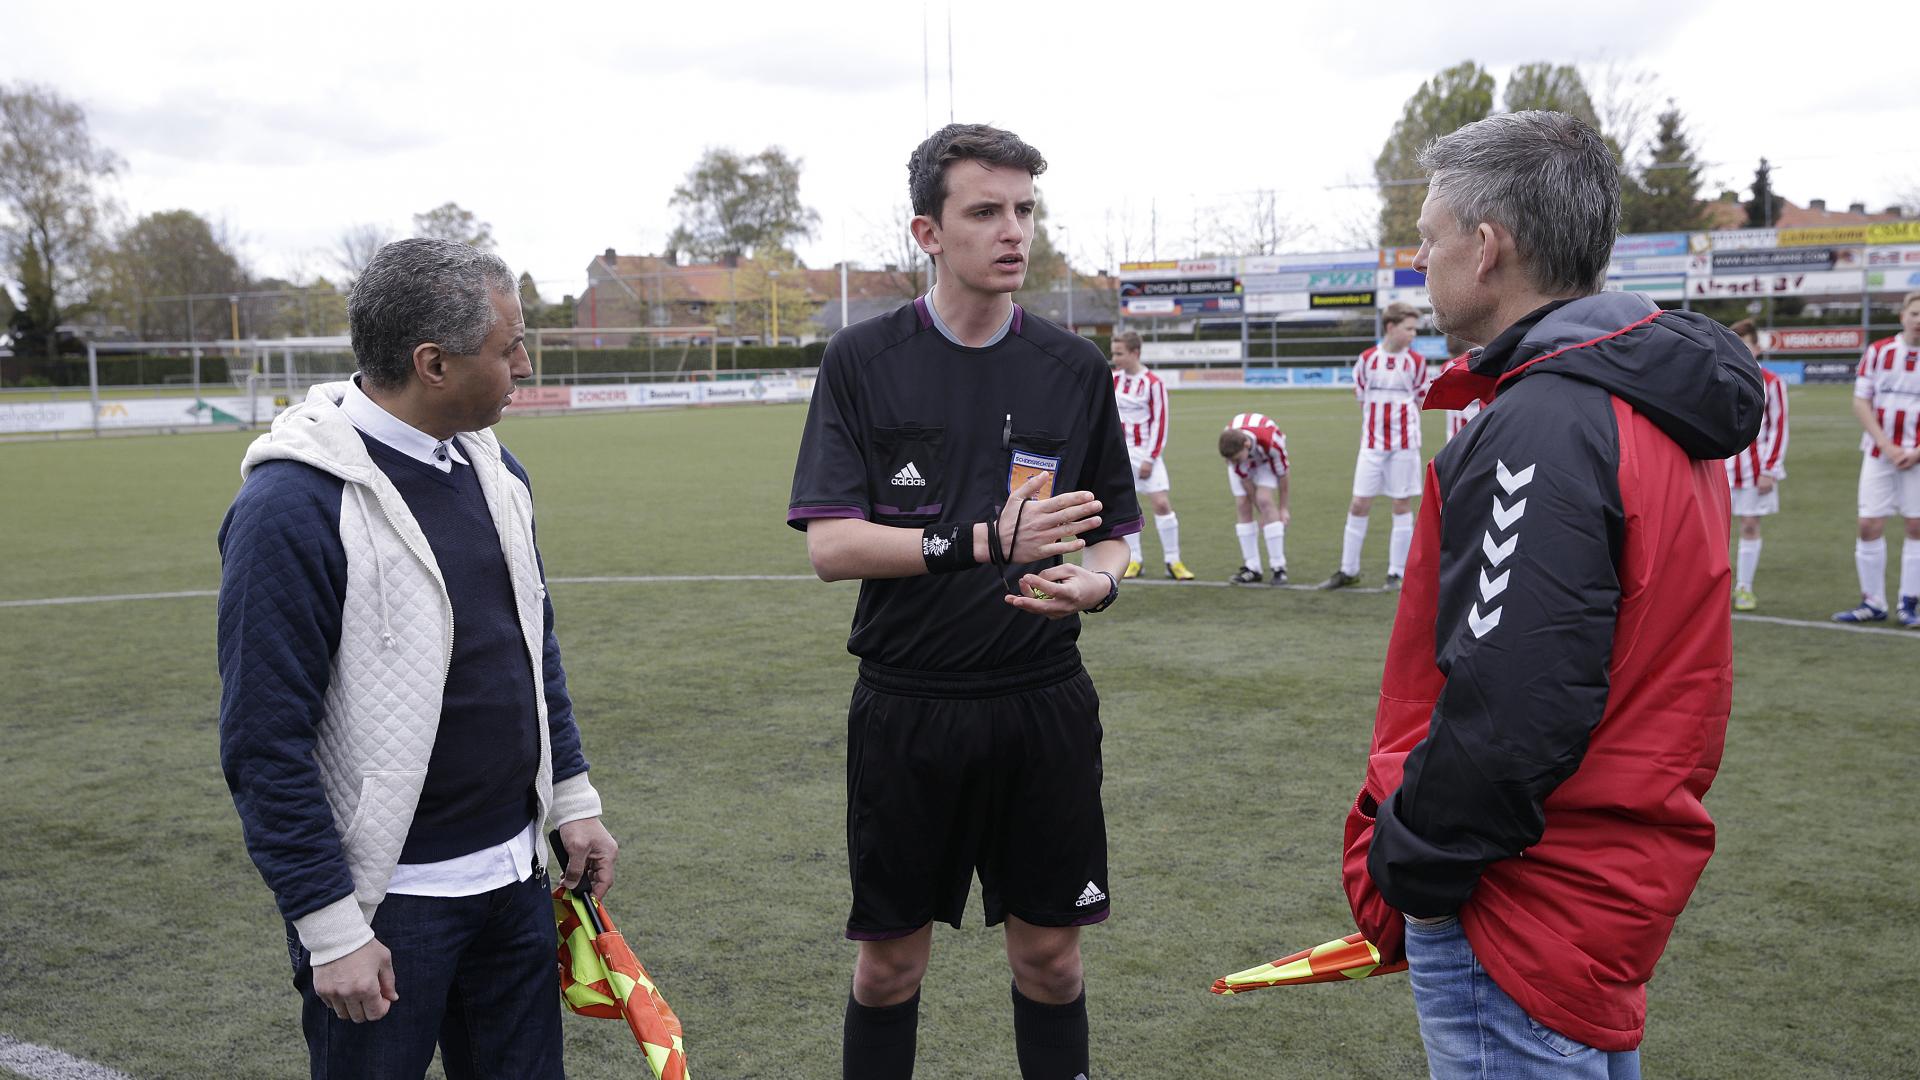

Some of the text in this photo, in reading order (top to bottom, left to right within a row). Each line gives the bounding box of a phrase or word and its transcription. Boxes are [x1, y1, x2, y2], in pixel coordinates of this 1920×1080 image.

[1144, 284, 1188, 295] CYCLING
[1190, 281, 1234, 292] SERVICE
[1782, 332, 1859, 349] VERHOEVEN
[577, 390, 628, 402] DONDERS
[891, 476, 926, 486] adidas
[1075, 892, 1106, 907] adidas
